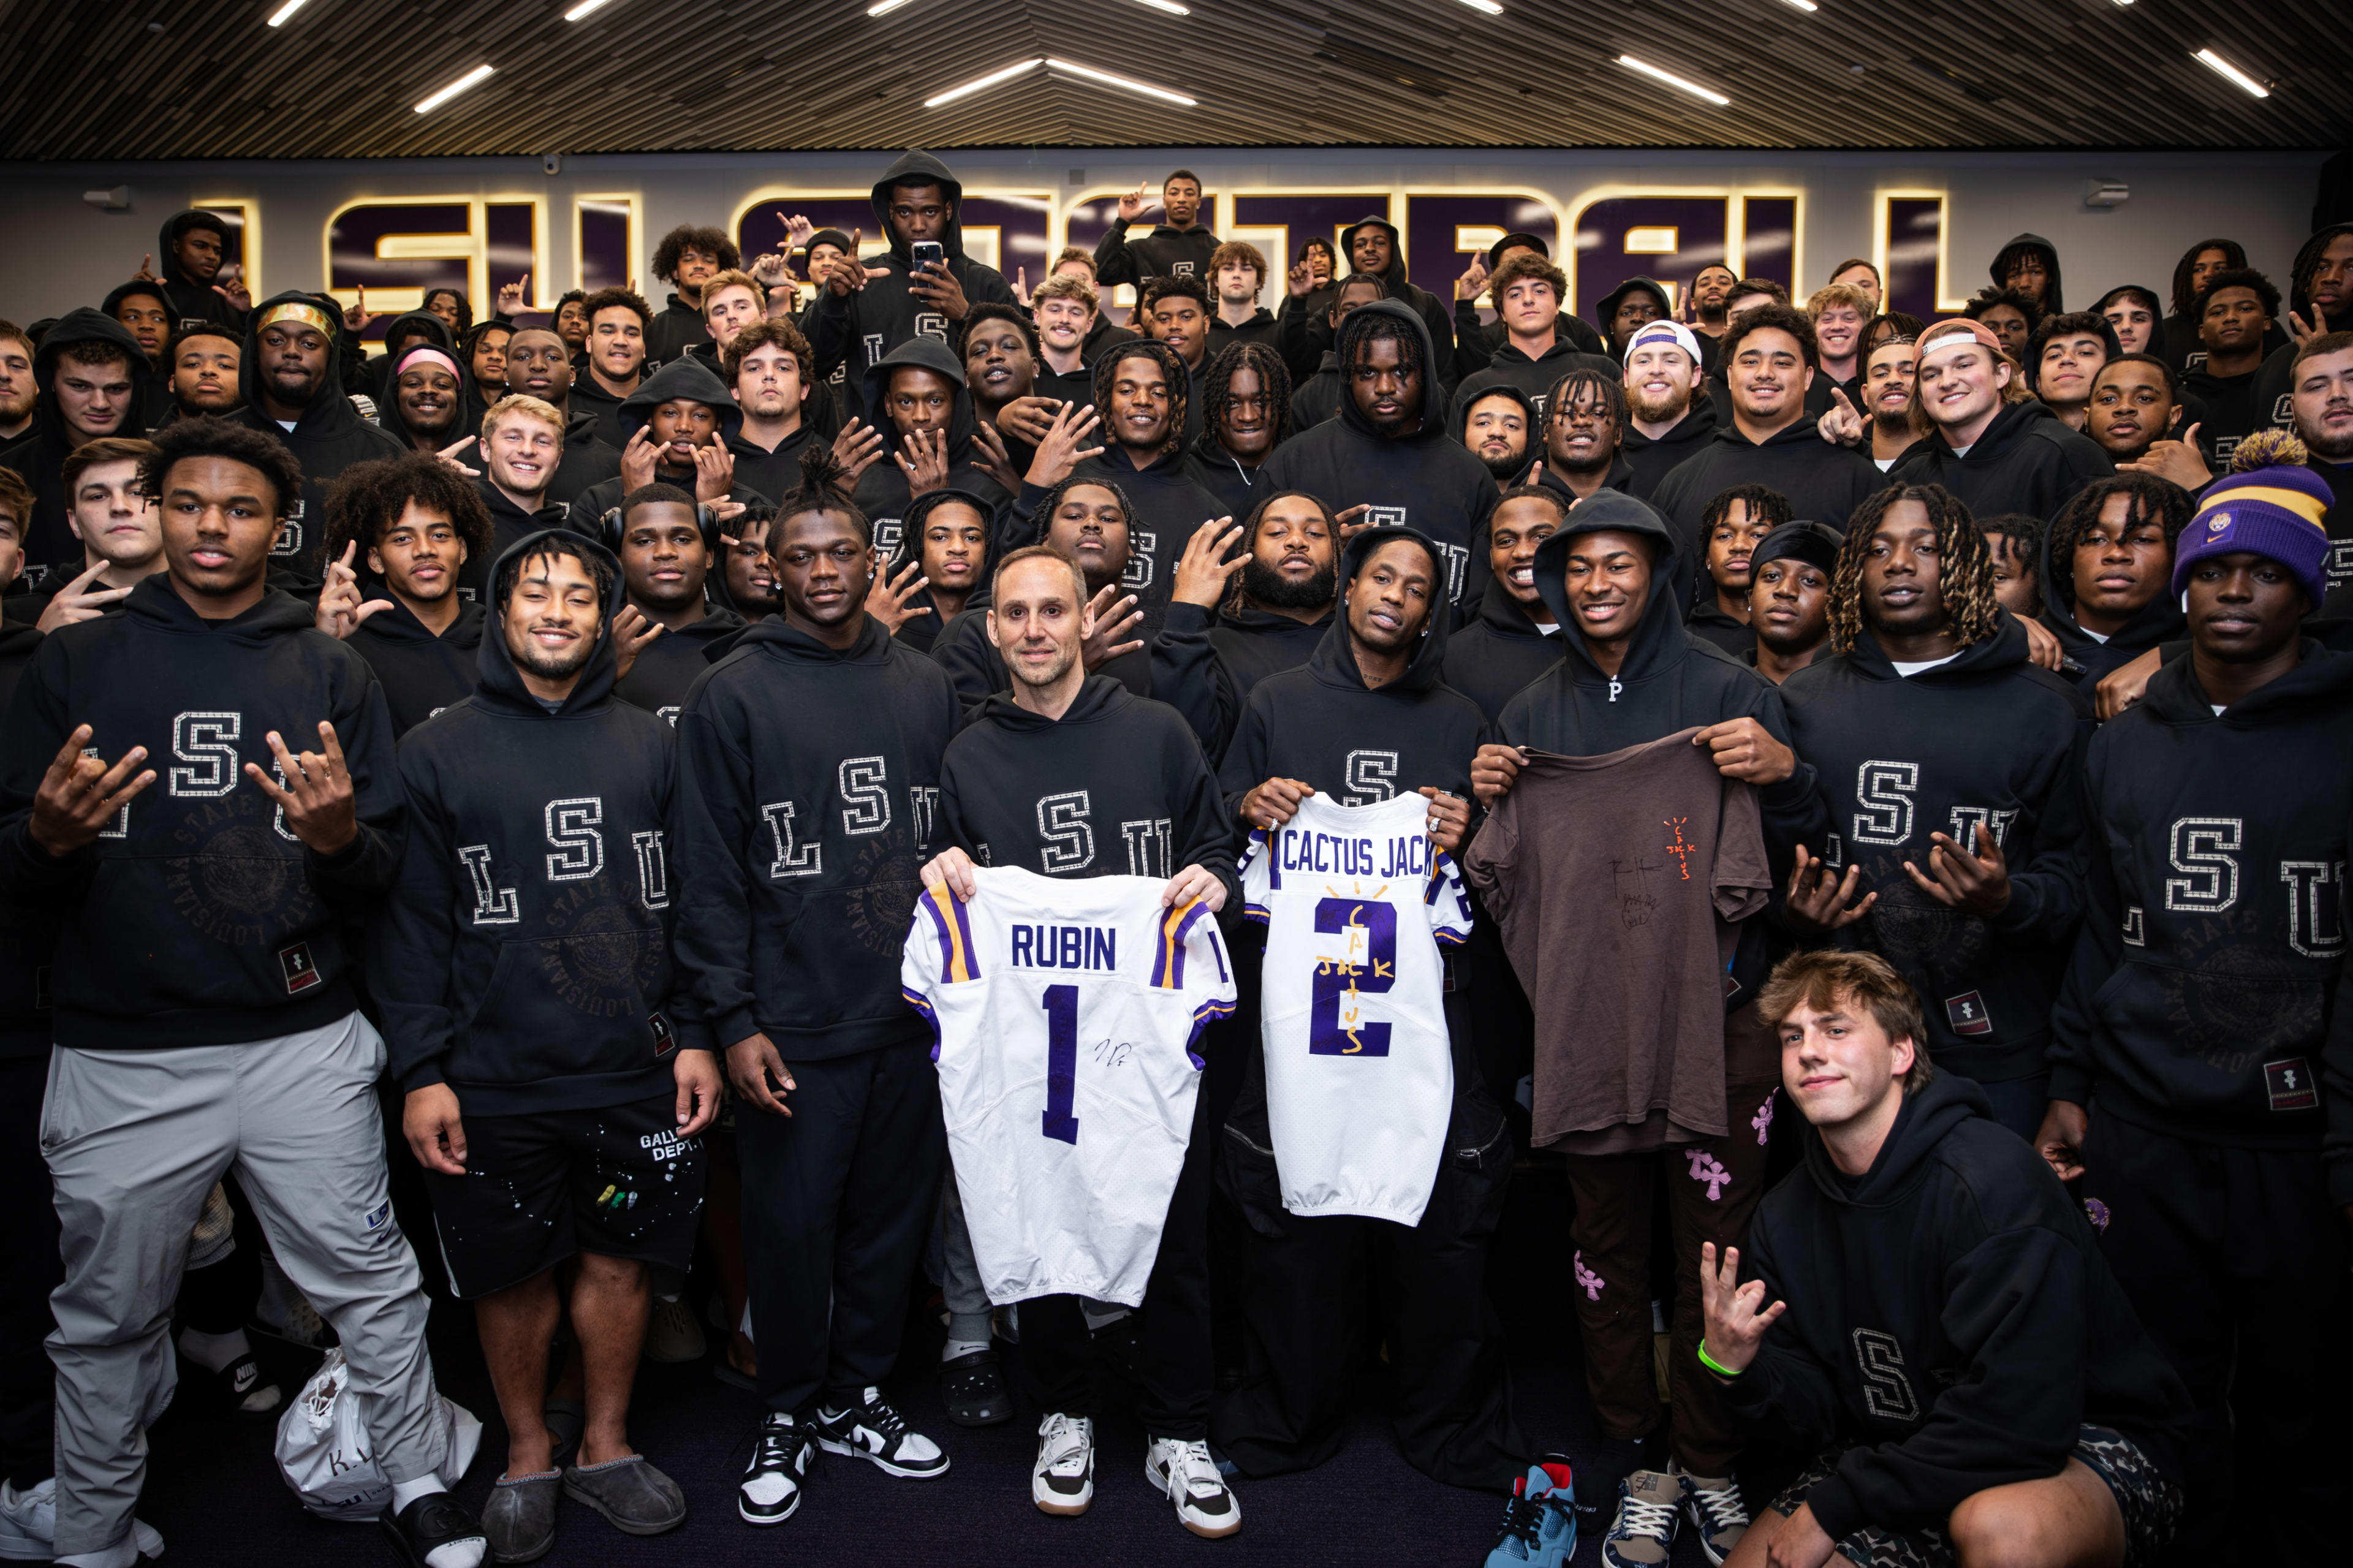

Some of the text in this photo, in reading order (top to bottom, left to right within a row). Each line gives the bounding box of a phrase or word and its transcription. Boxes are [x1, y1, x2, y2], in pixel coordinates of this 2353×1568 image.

[194, 201, 631, 343] SU
[1608, 681, 1623, 702] P
[762, 756, 939, 877] LSU
[1283, 829, 1373, 875] CACTUS
[457, 796, 670, 926] LSU
[1012, 924, 1116, 971] RUBIN
[1309, 897, 1398, 1057] 2
[1042, 984, 1079, 1145] 1
[653, 1139, 697, 1162] DEPT.
[366, 1199, 388, 1228] LS
